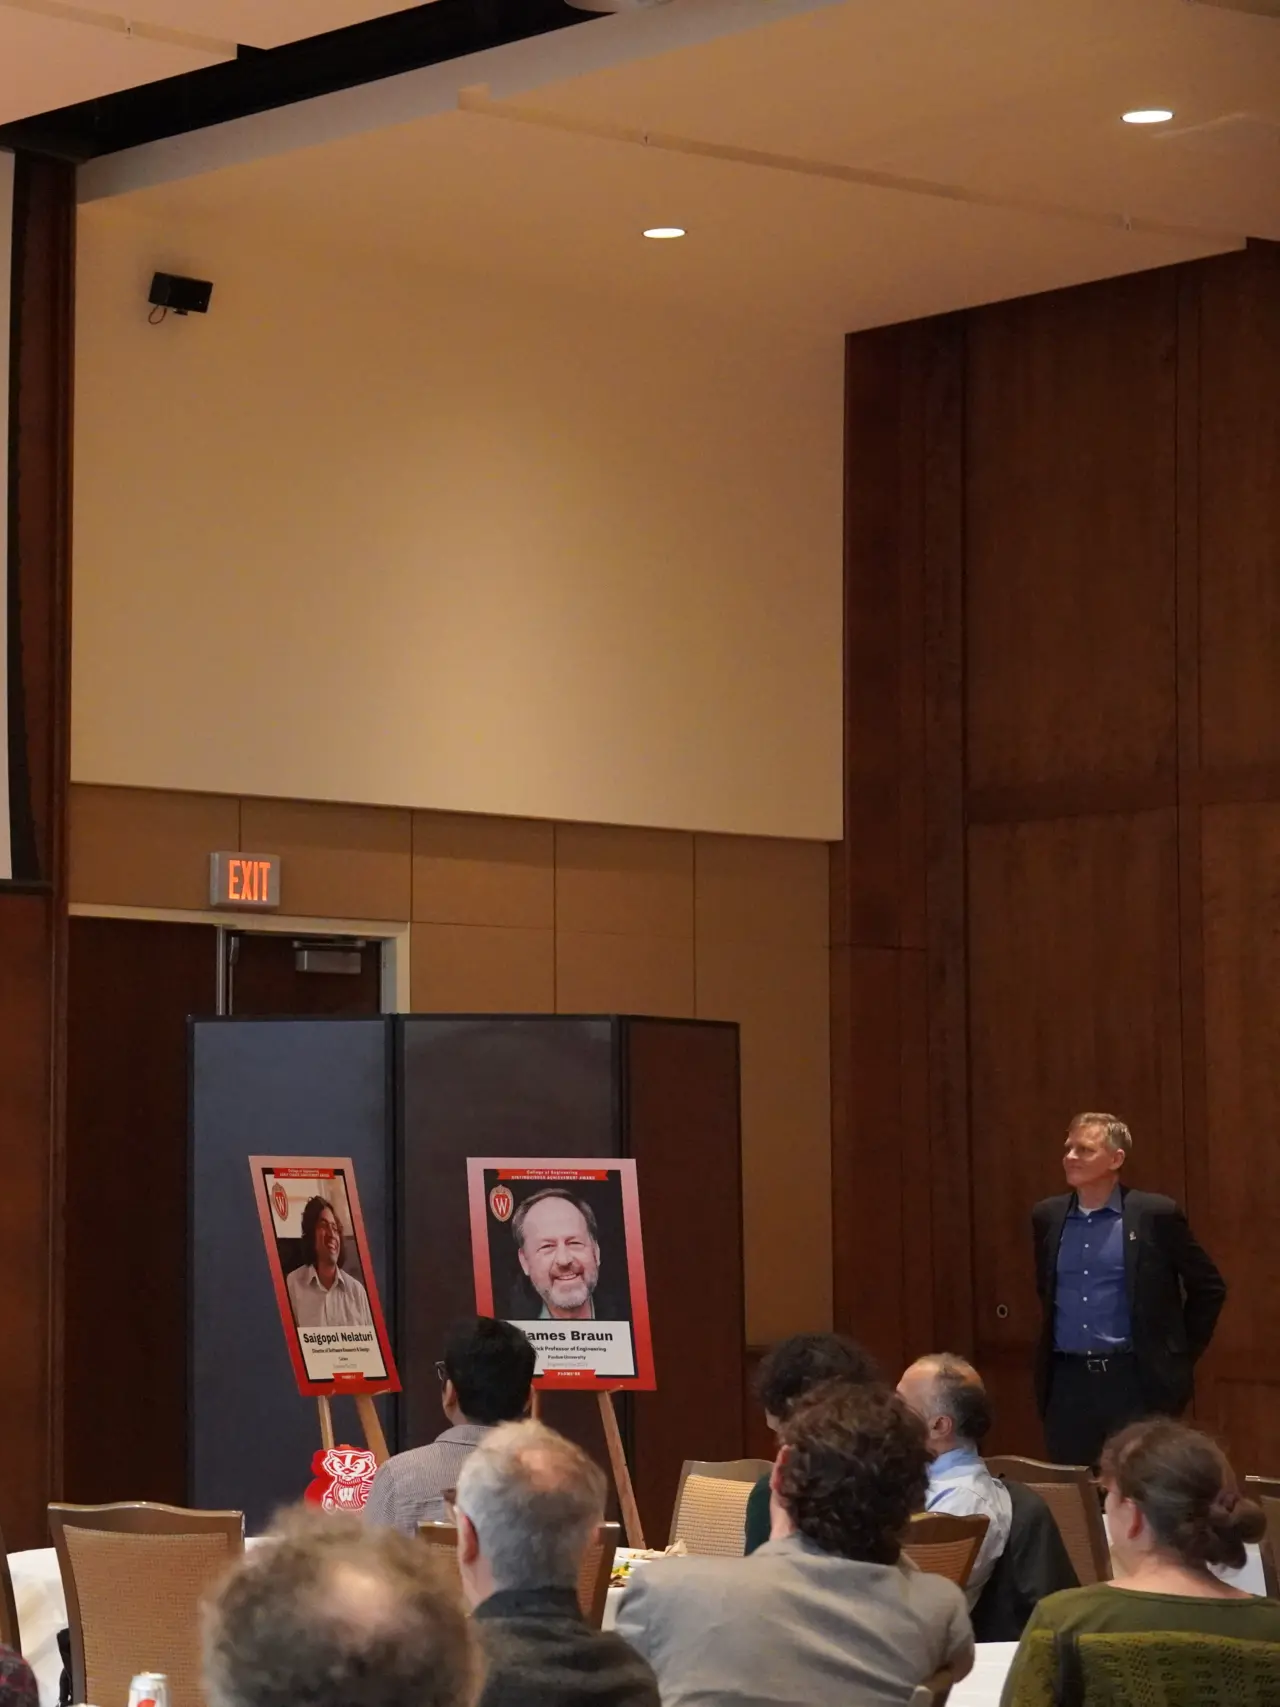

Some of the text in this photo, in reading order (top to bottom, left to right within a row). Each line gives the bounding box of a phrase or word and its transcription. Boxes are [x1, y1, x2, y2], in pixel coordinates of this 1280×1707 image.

[228, 859, 271, 902] EXIT
[495, 1198, 508, 1216] W
[340, 1331, 374, 1342] Nelaturi
[570, 1330, 614, 1341] Braun
[338, 1487, 355, 1502] W
